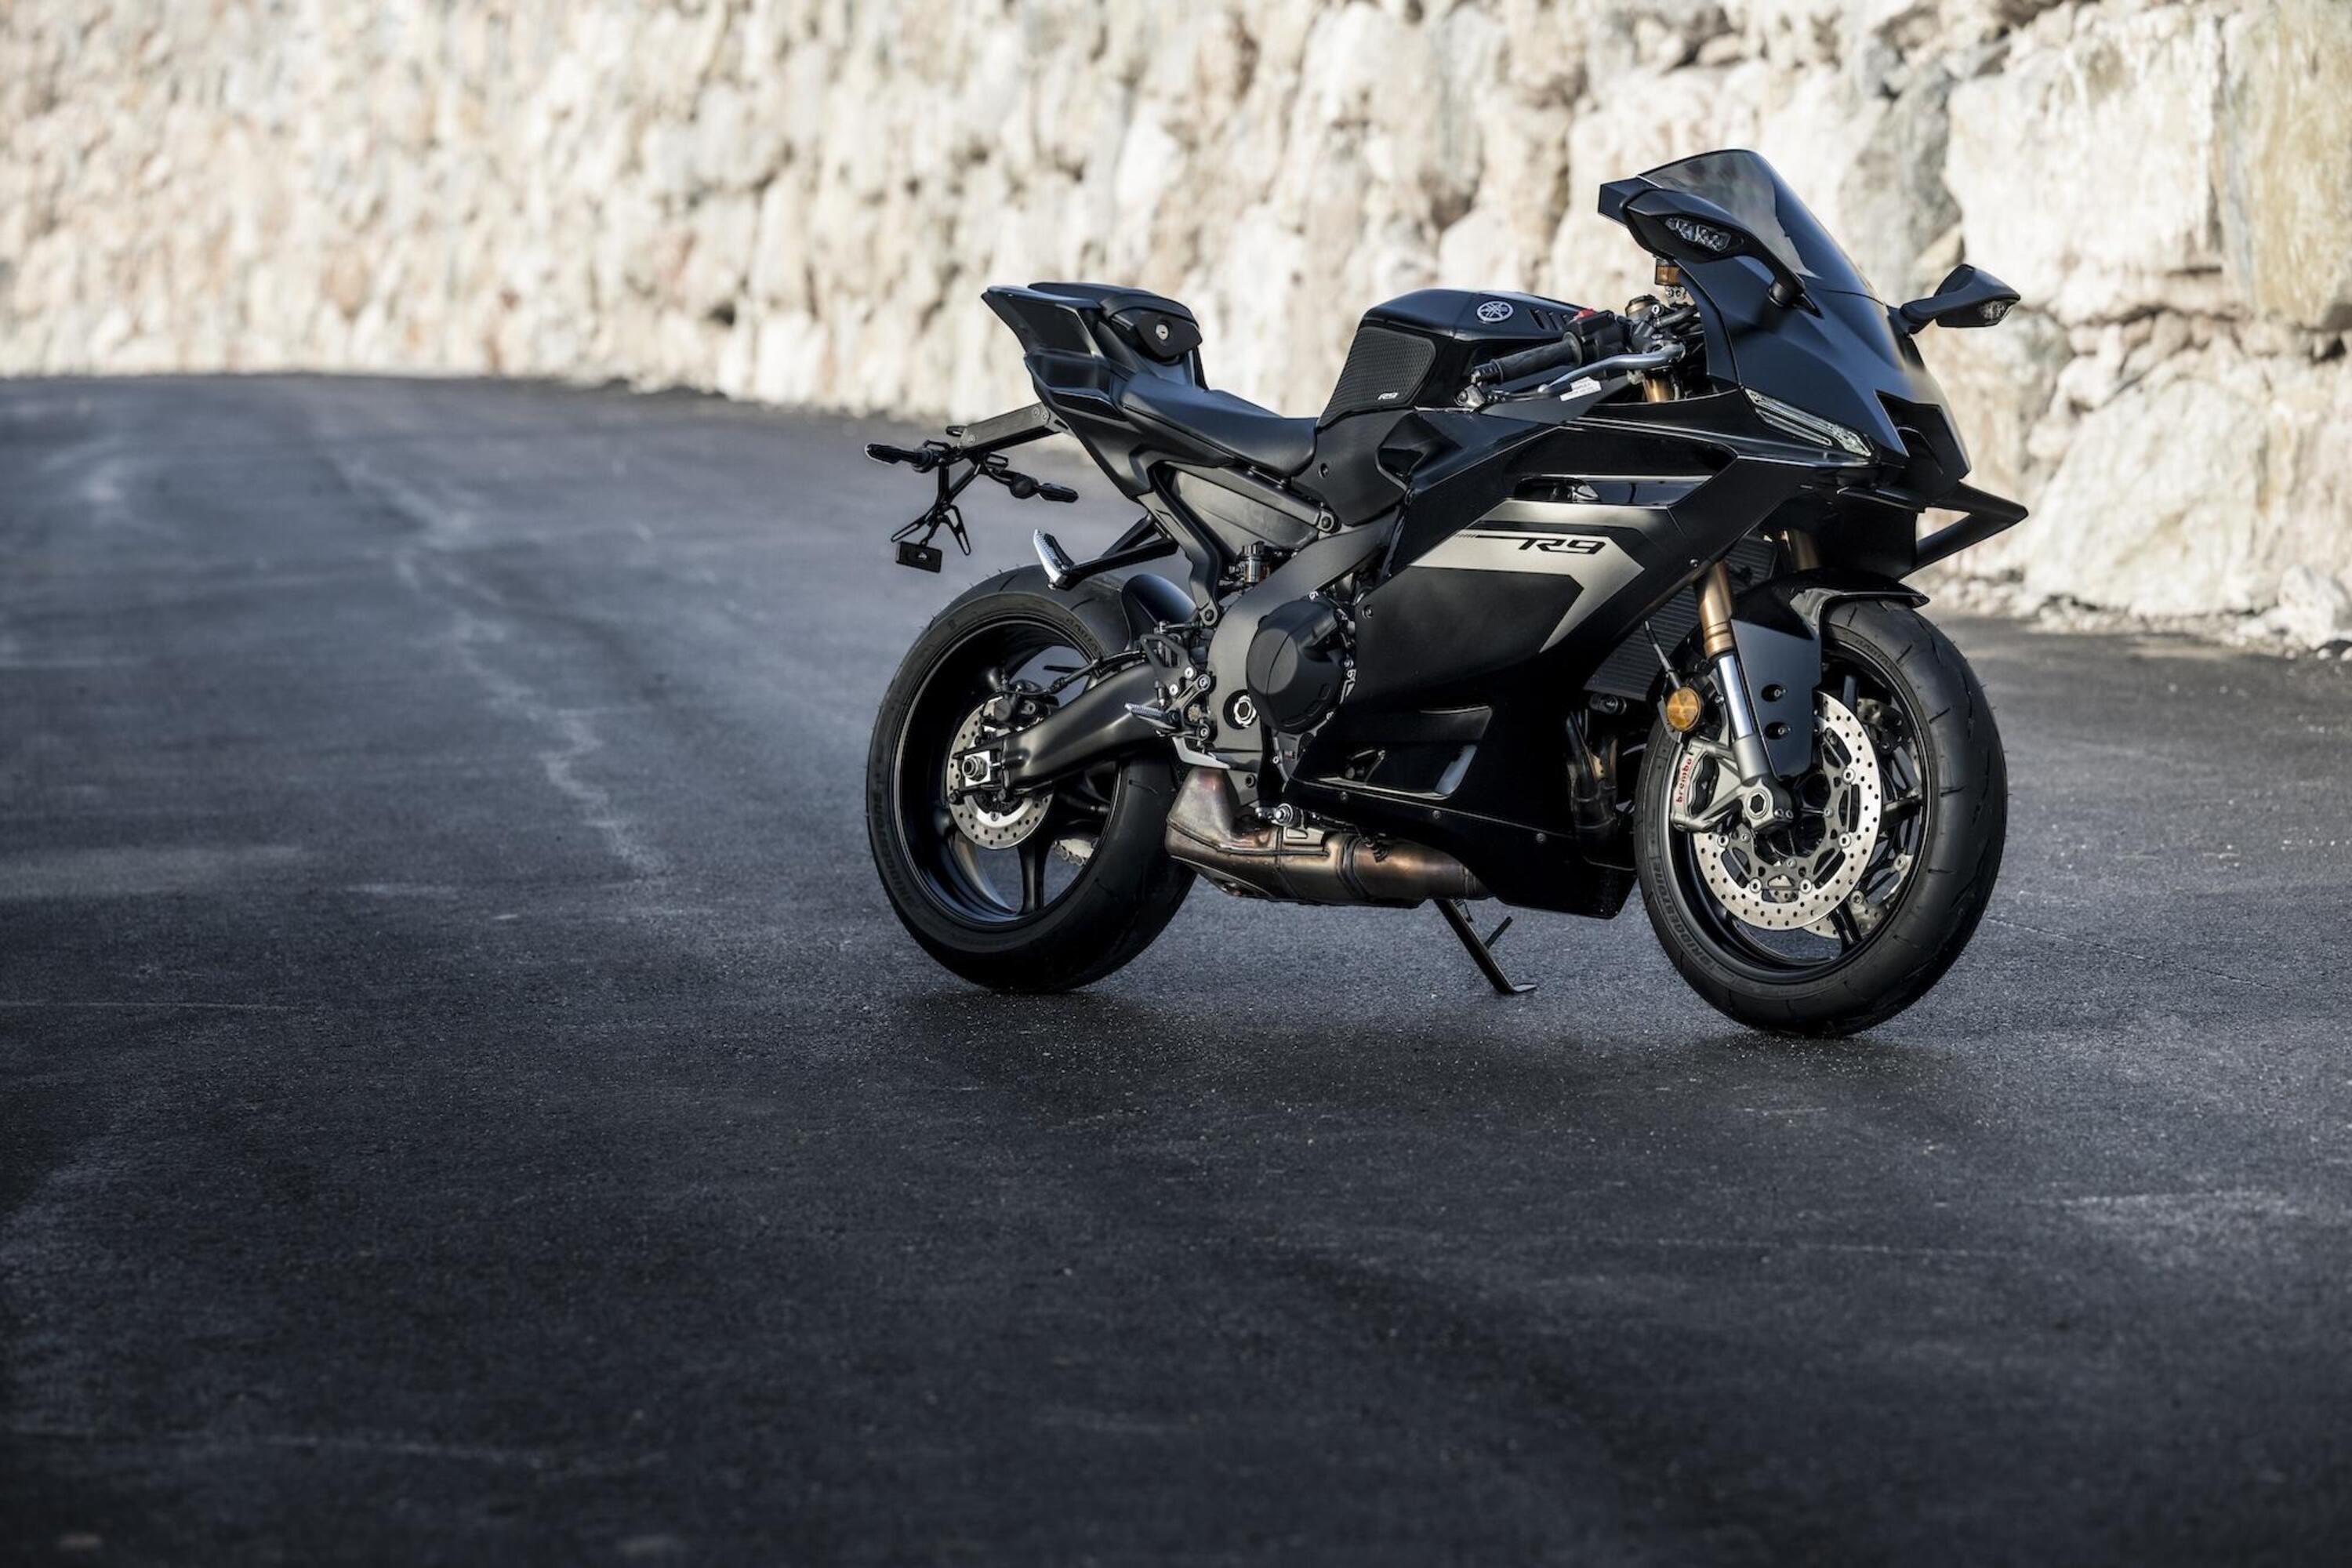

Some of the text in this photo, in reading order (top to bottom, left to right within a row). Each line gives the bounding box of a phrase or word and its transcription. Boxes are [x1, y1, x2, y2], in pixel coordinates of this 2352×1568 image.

[1518, 536, 1606, 555] R9
[1676, 757, 1692, 804] brembo
[1653, 861, 1713, 966] BRIDGESTONE
